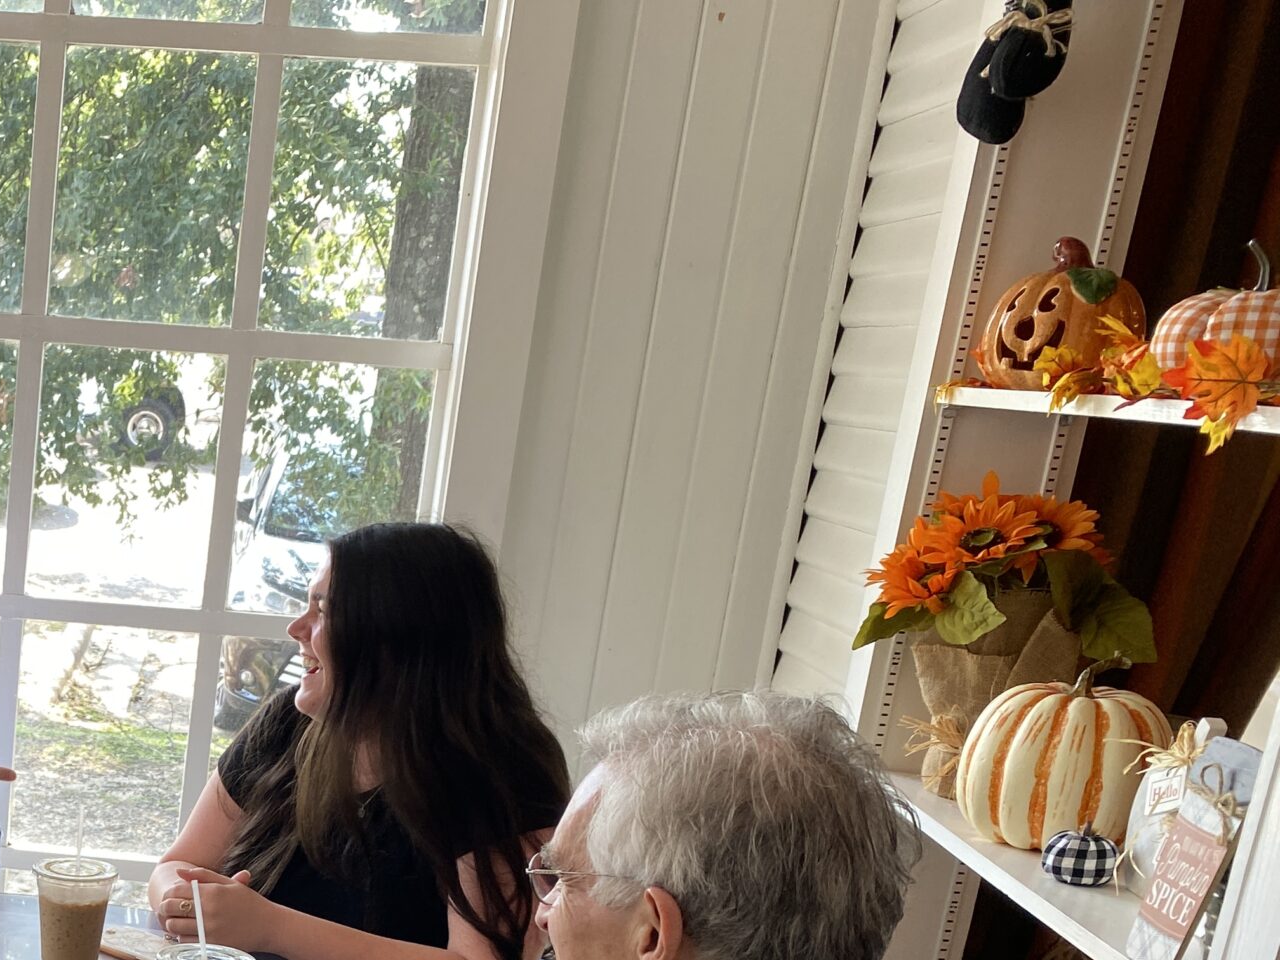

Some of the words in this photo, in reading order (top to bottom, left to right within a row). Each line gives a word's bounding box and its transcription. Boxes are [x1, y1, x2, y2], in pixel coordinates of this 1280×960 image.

[1153, 784, 1179, 801] Hello
[1156, 841, 1210, 898] Pumpkin
[1145, 878, 1196, 927] SPICE
